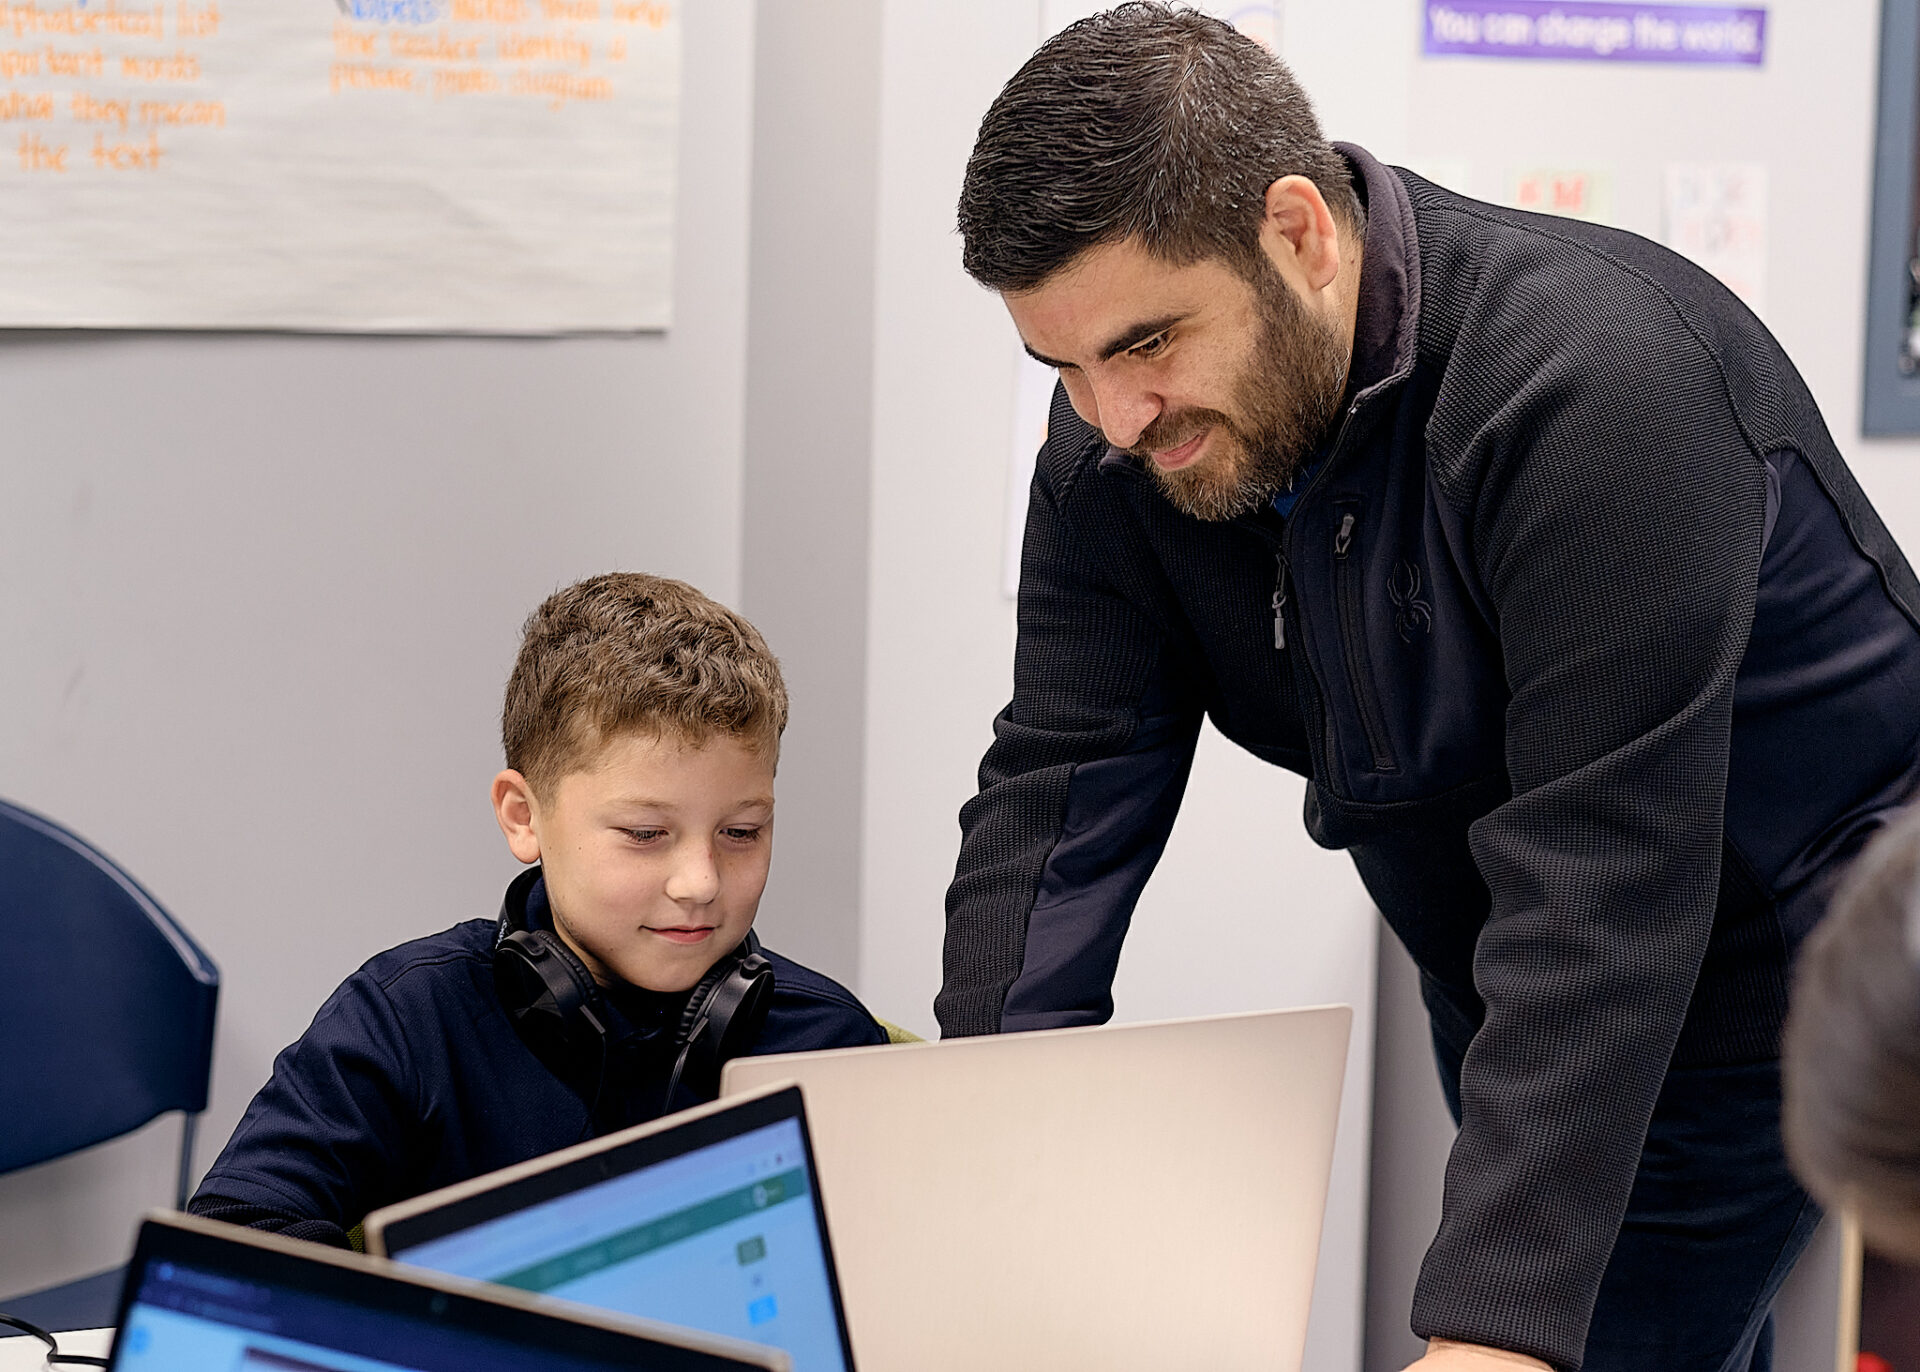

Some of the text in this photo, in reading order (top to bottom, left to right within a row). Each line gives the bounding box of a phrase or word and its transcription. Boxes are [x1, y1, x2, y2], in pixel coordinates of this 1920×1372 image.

[1430, 8, 1480, 45] You
[1482, 13, 1534, 46] can
[1536, 10, 1632, 55] change
[1634, 12, 1678, 51] the
[138, 98, 226, 128] mean
[17, 129, 164, 173] the text
